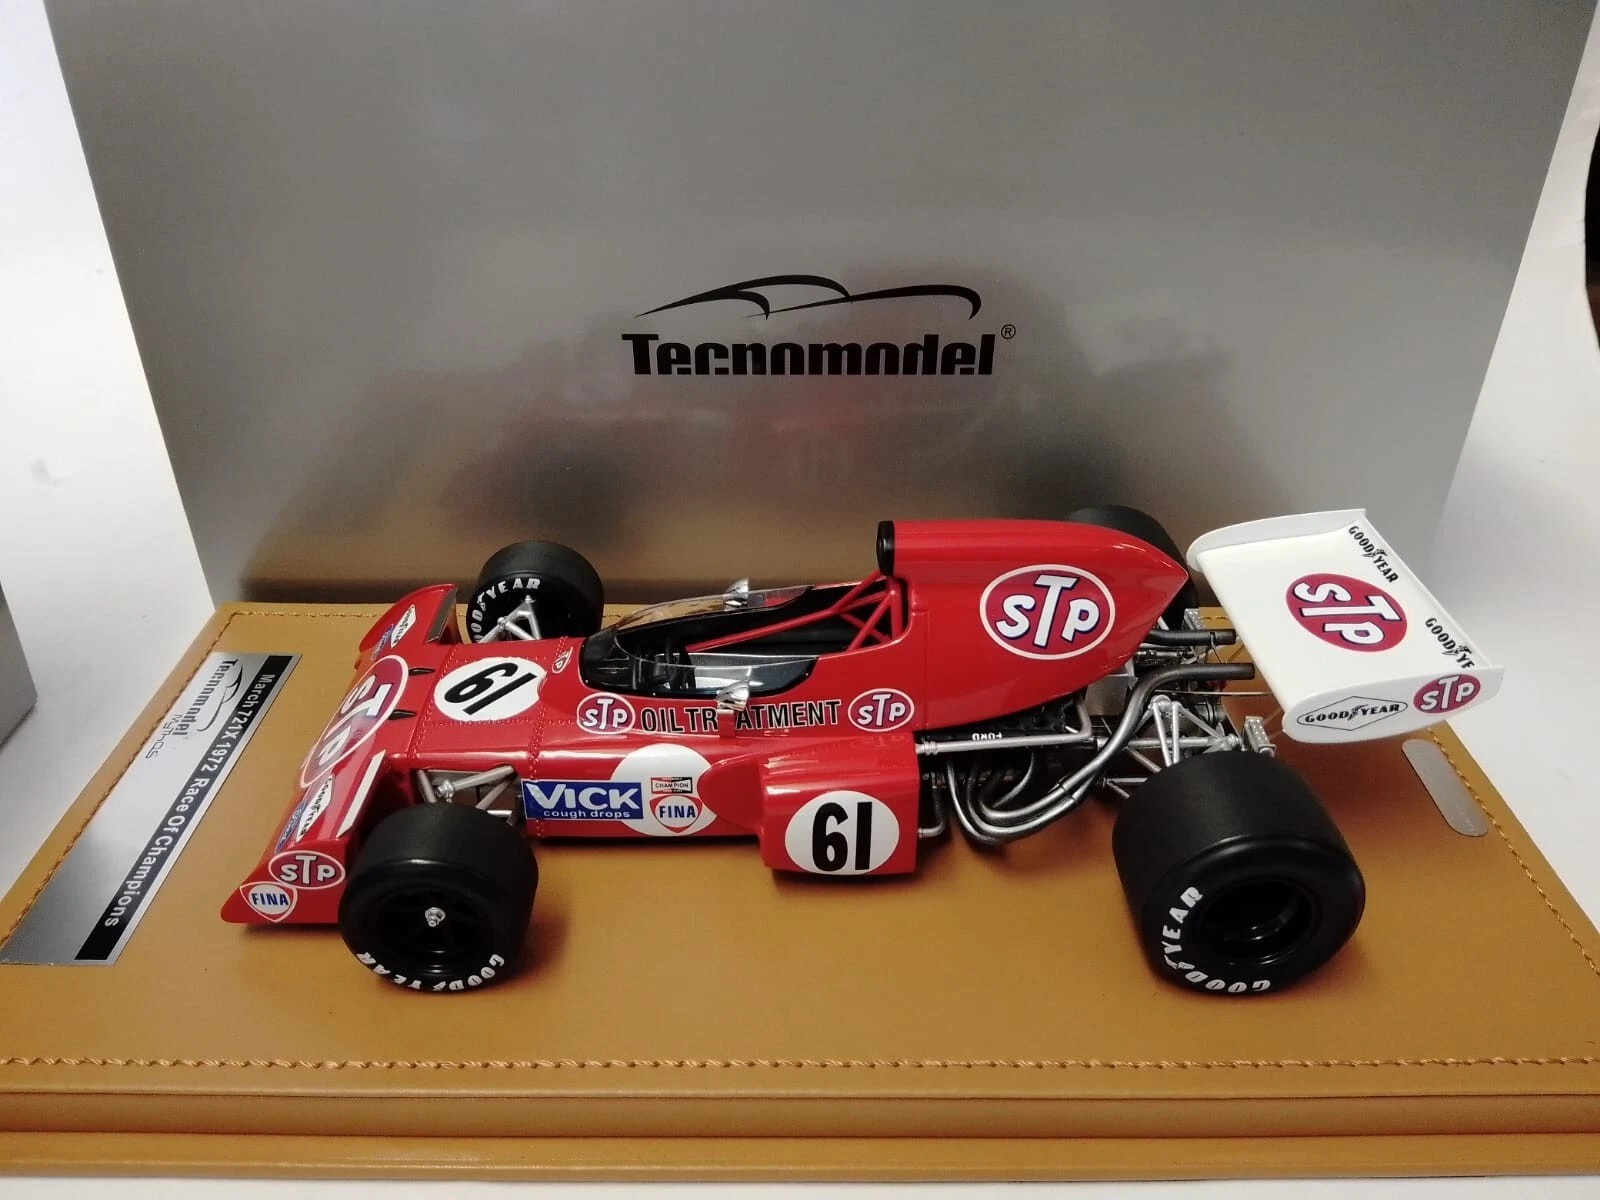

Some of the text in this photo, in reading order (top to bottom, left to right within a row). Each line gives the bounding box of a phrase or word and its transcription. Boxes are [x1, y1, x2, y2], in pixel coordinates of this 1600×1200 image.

[621, 333, 996, 376] Tecnomodel
[1348, 524, 1399, 584] GOODYEAR
[996, 574, 1100, 648] STP
[1293, 582, 1401, 646] STP
[172, 659, 239, 736] Tecnomodel
[444, 662, 537, 716] 61
[1421, 675, 1475, 711] STP
[318, 674, 393, 767] STP
[582, 698, 628, 730] STP
[641, 699, 842, 734] OIL TRATMENT
[857, 693, 906, 727] STP
[1304, 703, 1400, 723] GOODYEAR
[104, 674, 276, 927] March 721X 1972 Race Of Champions
[525, 783, 640, 810] VICK
[543, 809, 630, 820] cough drops
[659, 804, 696, 819] FINA
[811, 801, 872, 872] 61
[280, 855, 335, 885] STP
[251, 892, 289, 906] FINA
[1161, 886, 1271, 993] GOODYEAR
